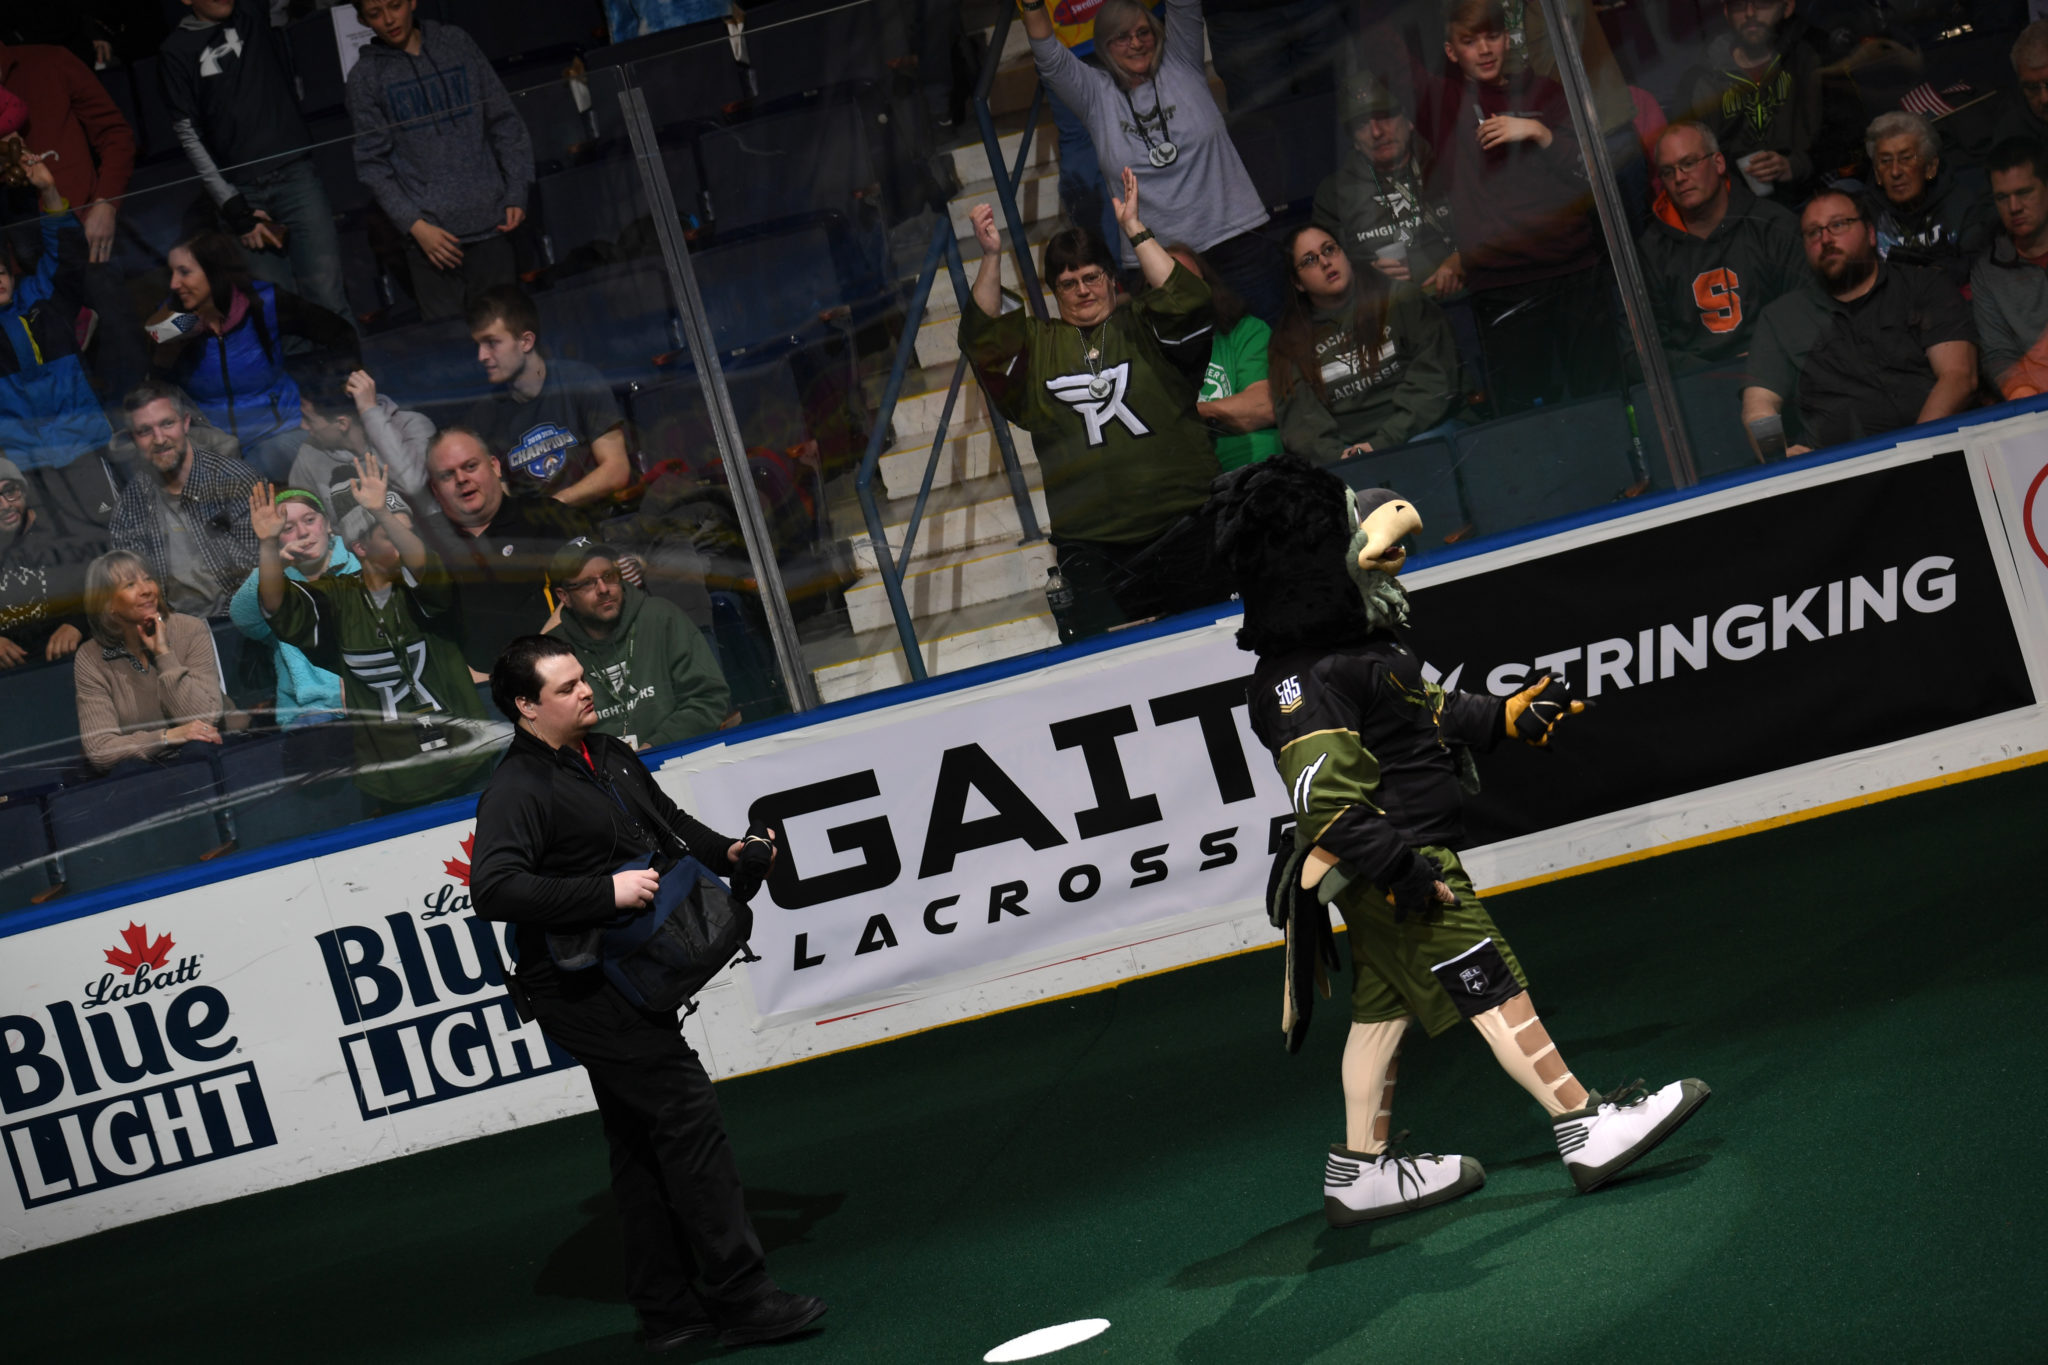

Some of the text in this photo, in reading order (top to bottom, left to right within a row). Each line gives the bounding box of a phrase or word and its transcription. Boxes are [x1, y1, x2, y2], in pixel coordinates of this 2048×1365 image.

[1692, 267, 1742, 333] S
[1486, 555, 1957, 698] STRINGKING
[1274, 674, 1302, 704] 585
[748, 674, 1256, 910] GAIT
[82, 955, 201, 1010] Labatt
[314, 911, 521, 1026] Blu
[0, 985, 238, 1115] Blue
[348, 1003, 552, 1112] LIGH
[10, 1069, 252, 1201] LIGHT
